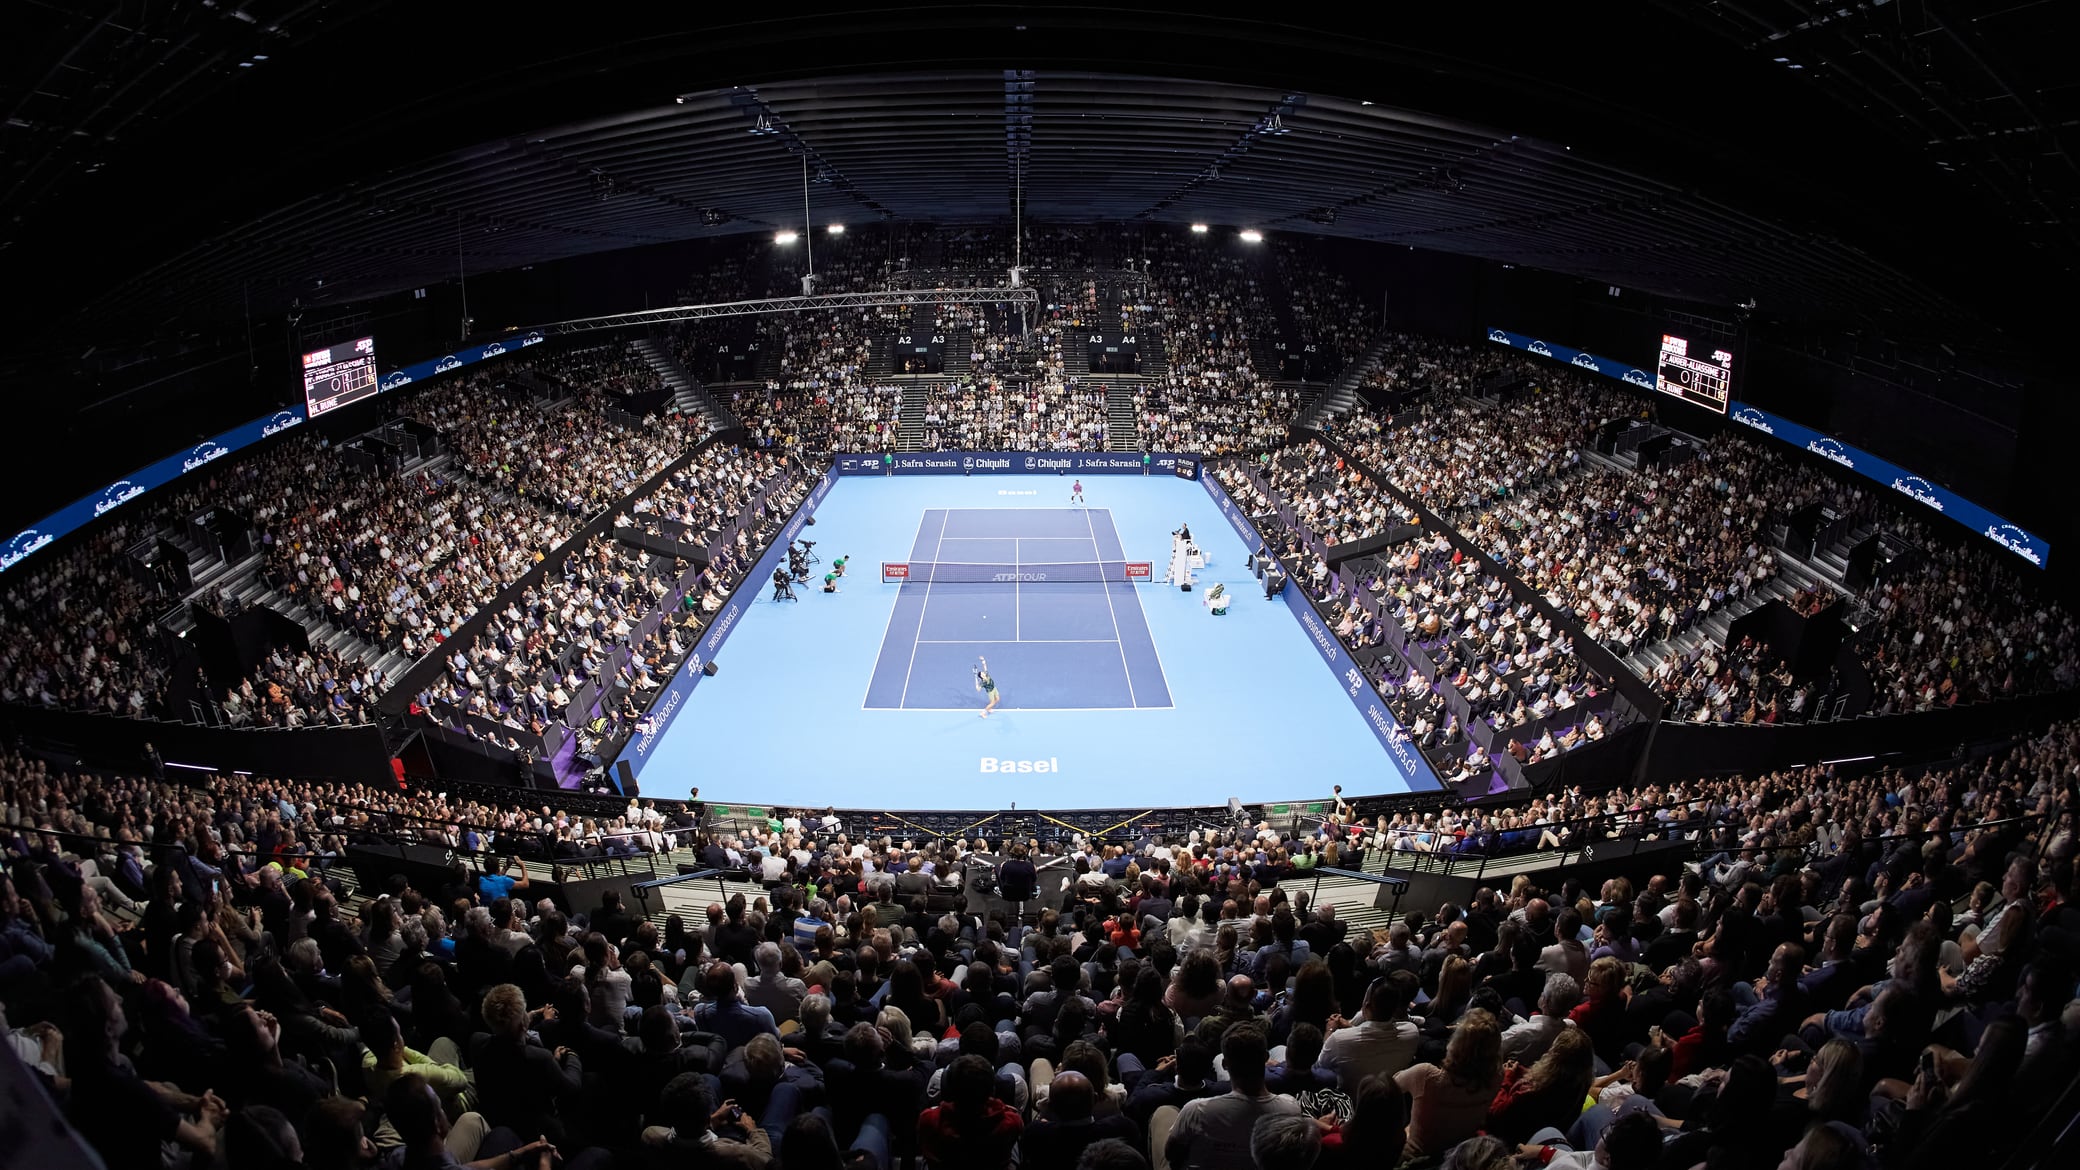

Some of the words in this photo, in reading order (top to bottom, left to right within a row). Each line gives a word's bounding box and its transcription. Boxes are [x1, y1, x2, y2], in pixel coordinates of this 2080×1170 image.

[898, 336, 912, 344] A2
[931, 335, 945, 344] A3
[1089, 335, 1103, 344] A3
[1122, 336, 1136, 344] A4
[718, 345, 729, 353] A1
[1304, 344, 1317, 352] A5
[1720, 371, 1726, 380] 3
[1667, 384, 1683, 396] RUNE
[1717, 390, 1725, 400] 15
[320, 398, 338, 411] RUNE
[902, 460, 924, 468] Safra
[925, 459, 957, 468] Sarasin
[976, 458, 1010, 470] Chiquita
[1037, 458, 1072, 470] Chiquita
[1085, 459, 1108, 467] Safra
[1109, 459, 1141, 467] Sarasin
[2001, 524, 2029, 543] CHAMPAGNE
[707, 603, 739, 651] swissindoors.ch
[1302, 611, 1337, 661] swissindoors.ch
[687, 653, 700, 678] ATP
[1345, 668, 1363, 689] ATP
[980, 757, 1058, 773] Basel
